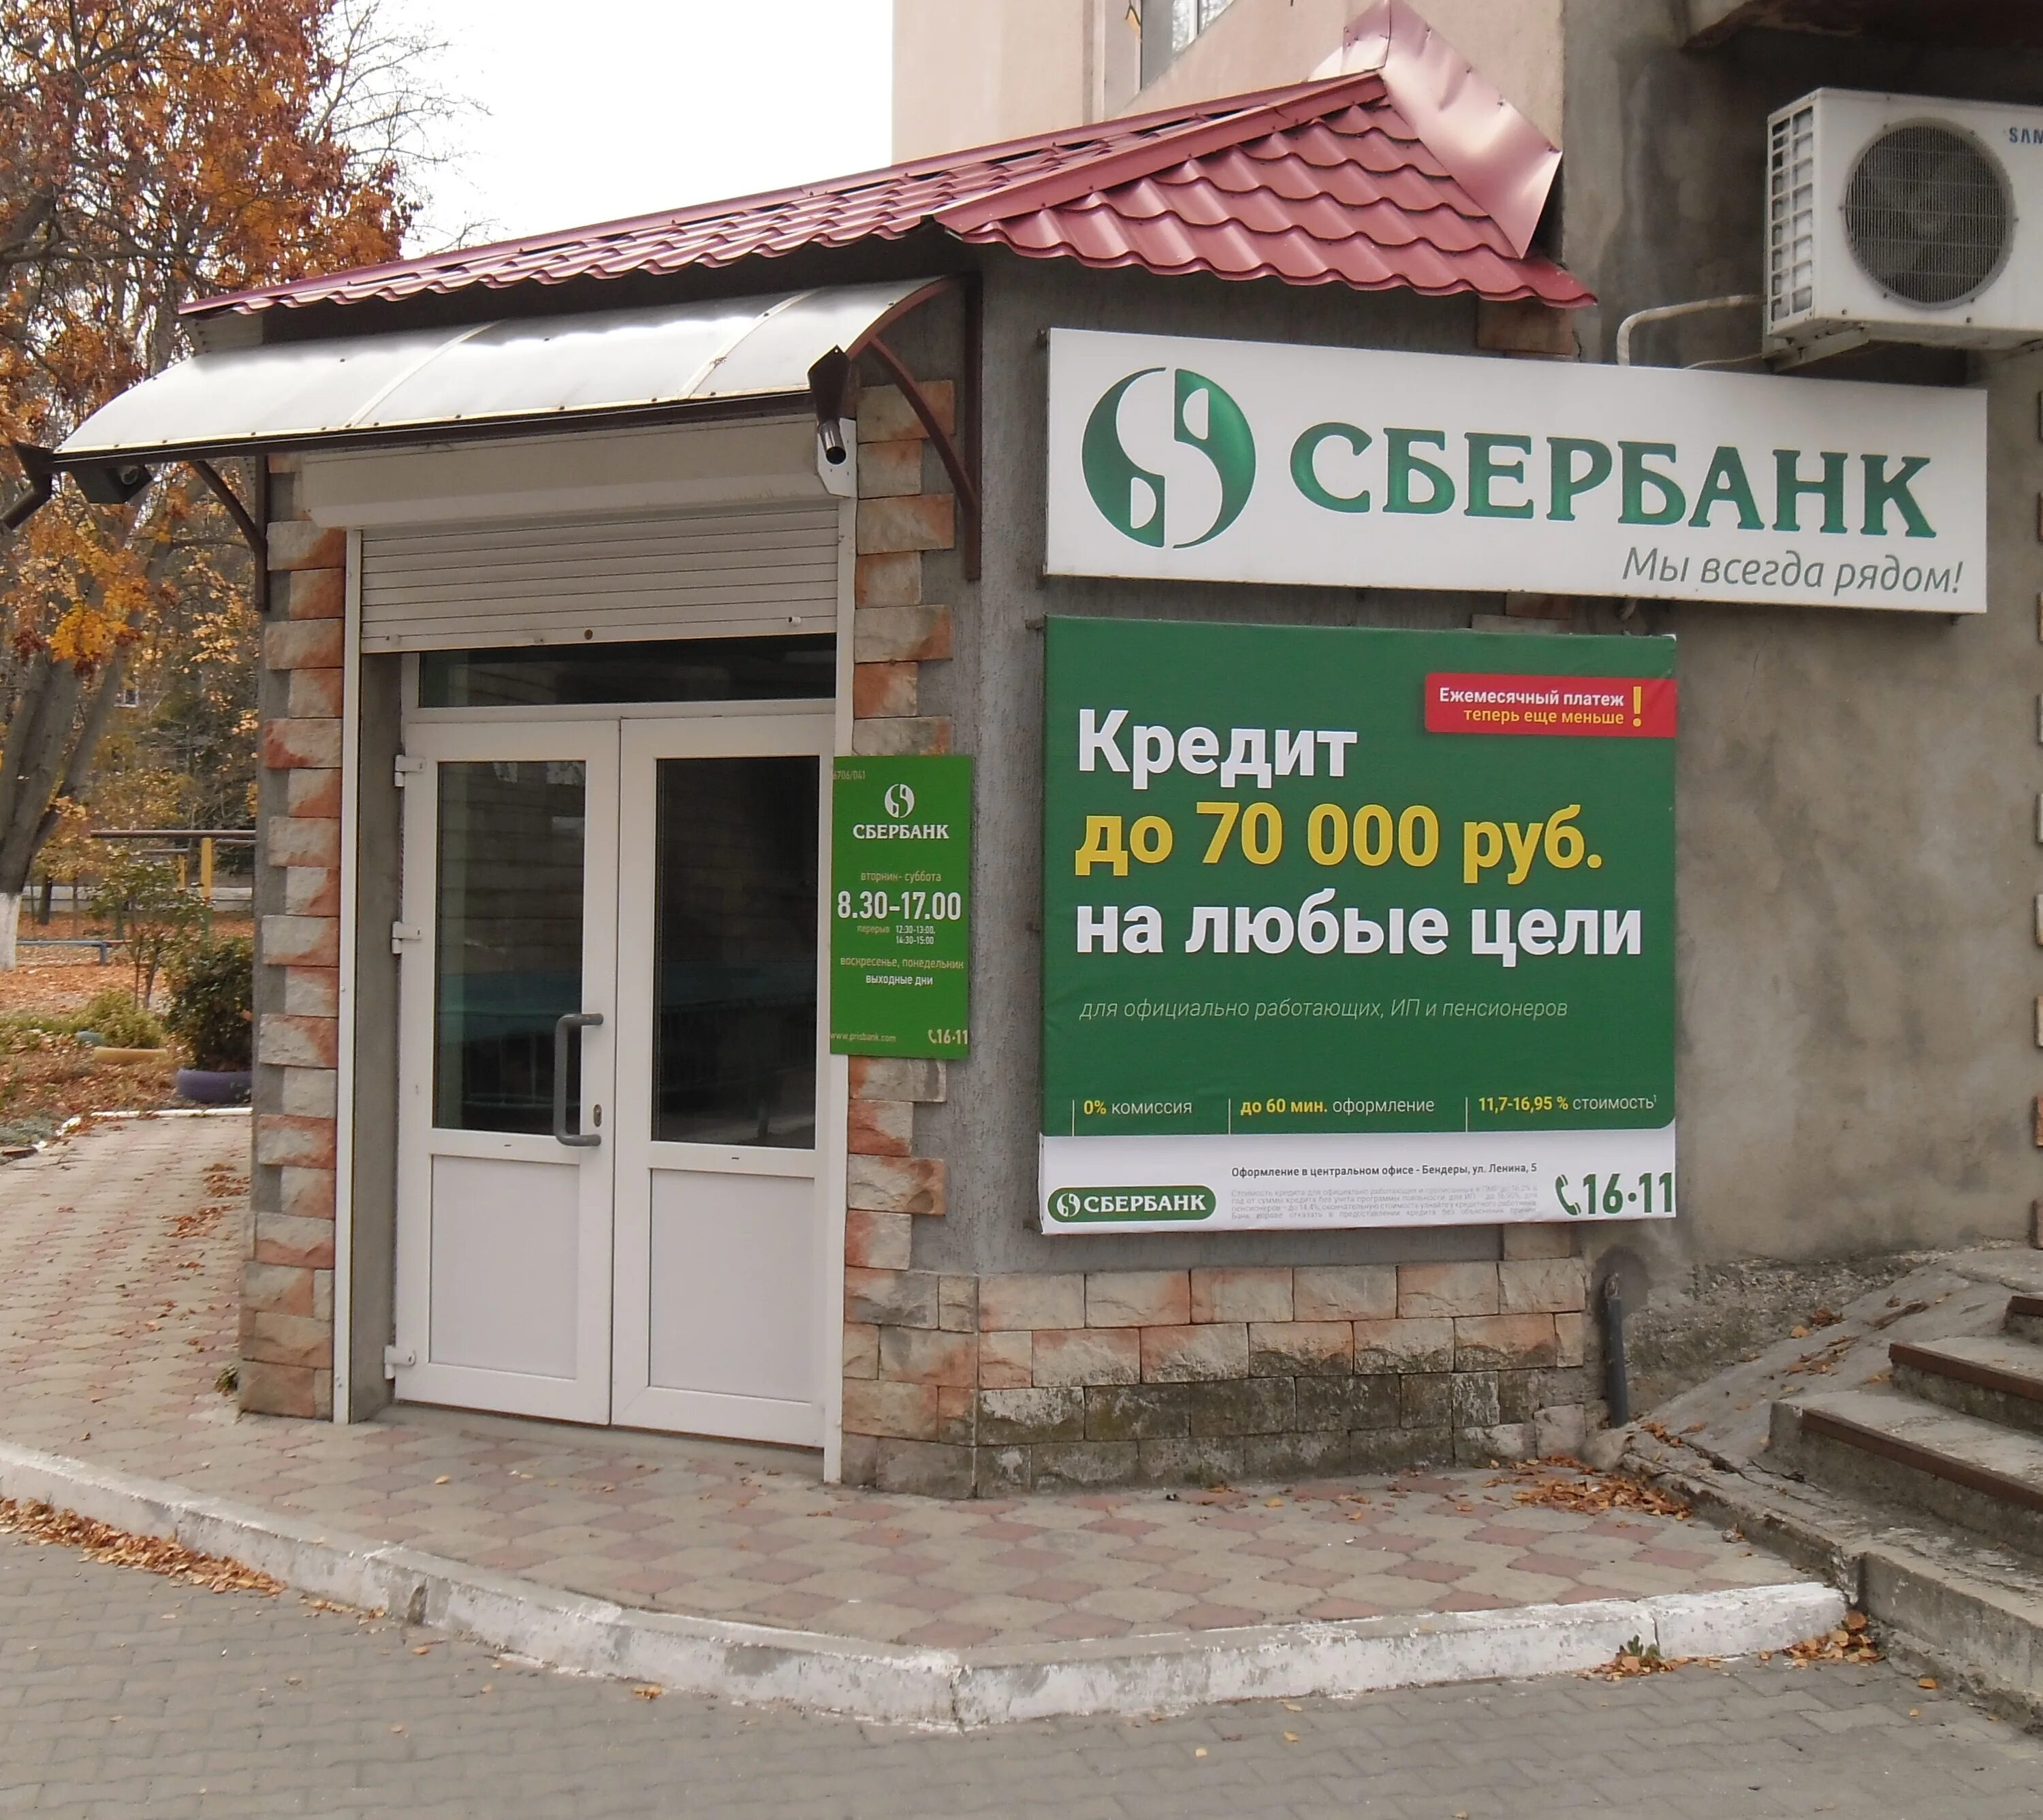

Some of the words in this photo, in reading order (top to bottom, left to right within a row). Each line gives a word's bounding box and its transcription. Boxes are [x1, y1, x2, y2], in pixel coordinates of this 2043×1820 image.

[1290, 422, 1937, 539] СБЕРБАНК
[1622, 547, 1690, 583] Мы
[1700, 549, 1824, 588] всегда
[1833, 555, 1963, 596] рядом!
[1439, 687, 1559, 705] Ежемесячный
[1564, 692, 1624, 707] платеж
[1463, 709, 1520, 724] теперь
[1524, 710, 1557, 724] еще
[1562, 712, 1624, 724] меньше
[1079, 709, 1358, 790] Кредит
[853, 824, 949, 839] СБЕРБАНК
[1075, 814, 1173, 877] до
[1196, 801, 1283, 865] 70
[1308, 804, 1439, 868] 000
[1463, 804, 1603, 884] руб.
[905, 871, 942, 884] суббота
[838, 891, 962, 920] 8.30-17.00
[857, 925, 890, 934] перерыв
[1077, 904, 1163, 954] на
[1185, 887, 1448, 956] любые
[1471, 906, 1641, 967] цели
[896, 936, 934, 944] 14:30-15:00
[840, 957, 900, 968] воскресенье,
[902, 959, 964, 970] понедельник
[866, 974, 913, 985] выходные
[915, 976, 934, 987] дни
[1079, 1000, 1118, 1020] для
[1123, 999, 1250, 1020] официально
[1254, 1000, 1384, 1021] работающих,
[1389, 999, 1421, 1017] ИП
[1425, 1003, 1436, 1017] и
[1442, 1002, 1568, 1021] пенсионеров
[1083, 1100, 1107, 1115] 0%
[1111, 1101, 1192, 1115] комиссия
[1240, 1101, 1262, 1116] до
[1267, 1099, 1286, 1113] 60
[1290, 1100, 1328, 1113] мин.
[1332, 1098, 1435, 1116] оформление
[1478, 1096, 1553, 1114] 11,7-16,95
[1556, 1096, 1568, 1111] %
[1231, 1166, 1299, 1179] Оформление
[1310, 1167, 1379, 1178] центральном
[1382, 1165, 1414, 1177] офисе
[1422, 1164, 1470, 1176] Бендеры,
[1472, 1166, 1487, 1175] ул.
[1489, 1163, 1529, 1174] Ленина,
[1531, 1162, 1537, 1172] 5
[1083, 1194, 1207, 1213] СБЕРБАНК
